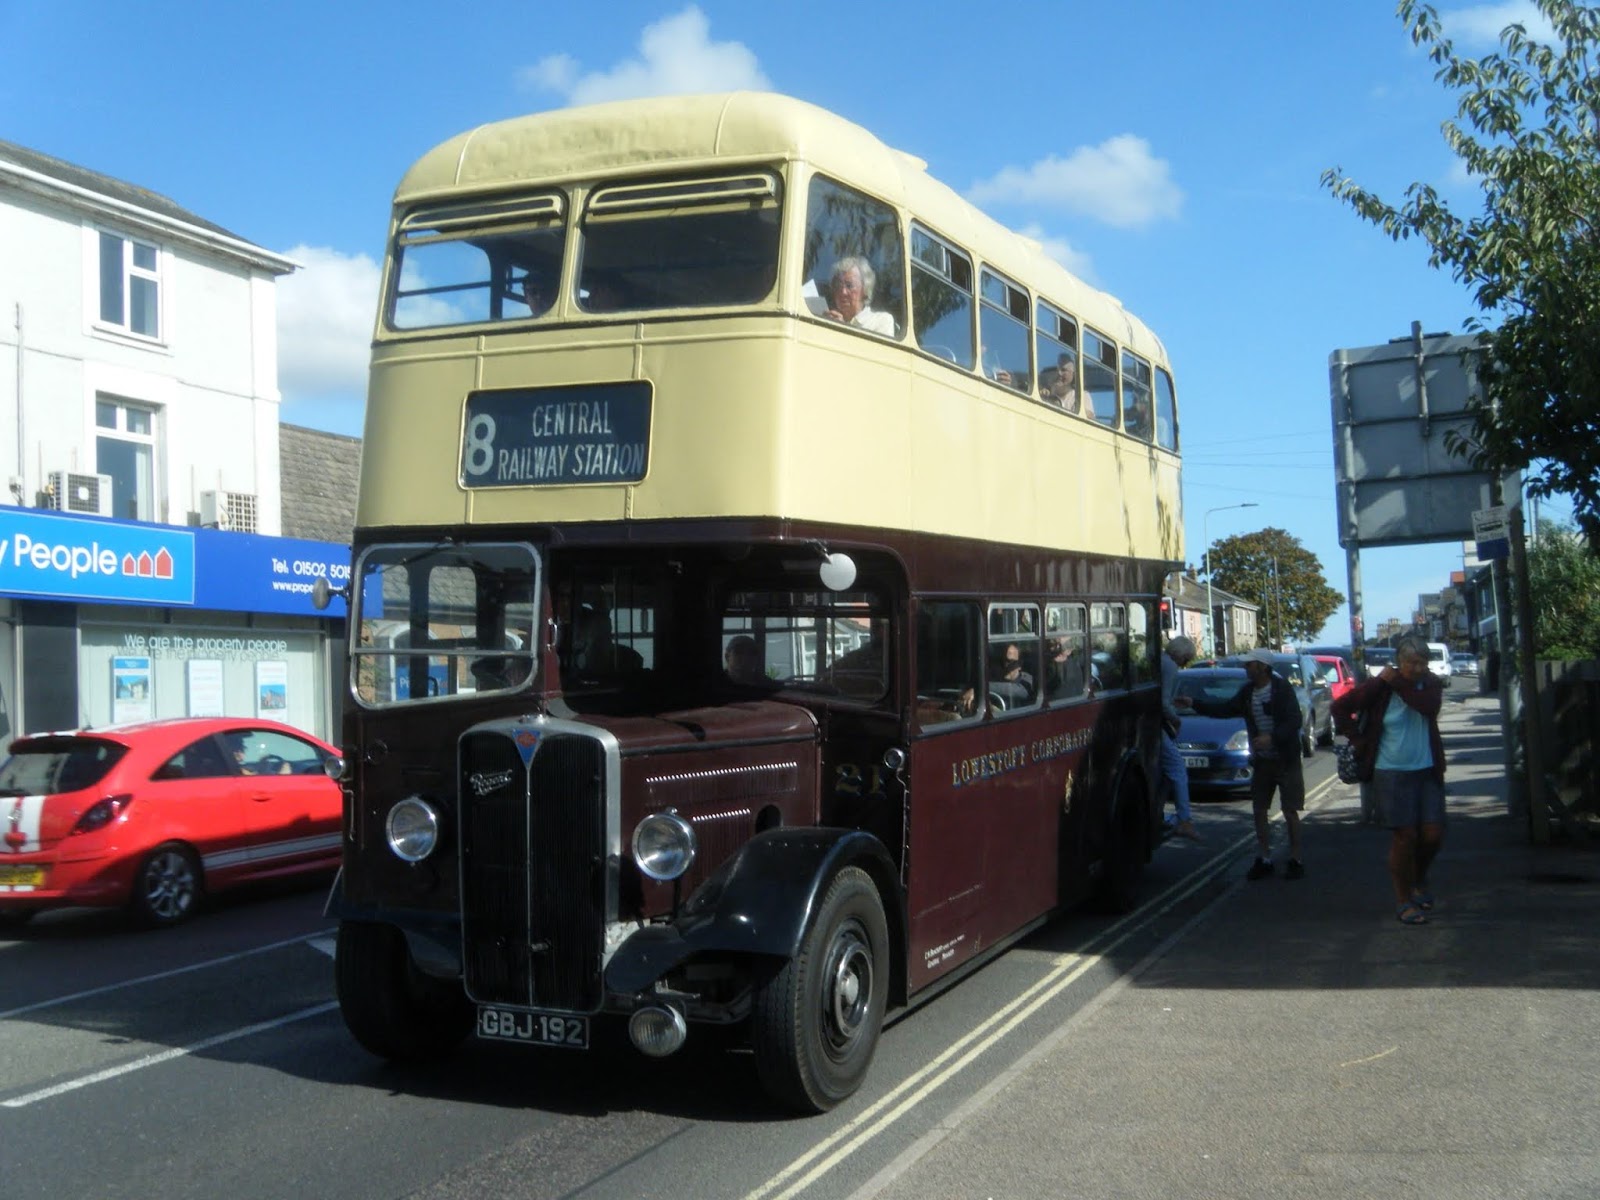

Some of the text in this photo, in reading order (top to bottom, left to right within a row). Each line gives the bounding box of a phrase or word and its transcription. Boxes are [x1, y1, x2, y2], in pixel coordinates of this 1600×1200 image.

[532, 401, 612, 437] CENTRAL
[466, 413, 496, 476] 8
[497, 443, 645, 480] RAILWAY STATION
[14, 533, 118, 579] People
[293, 560, 326, 577] 01502
[124, 634, 287, 653] We are the property people
[952, 745, 1026, 787] LOWESTOFT
[482, 1010, 583, 1044] GBJ 192
